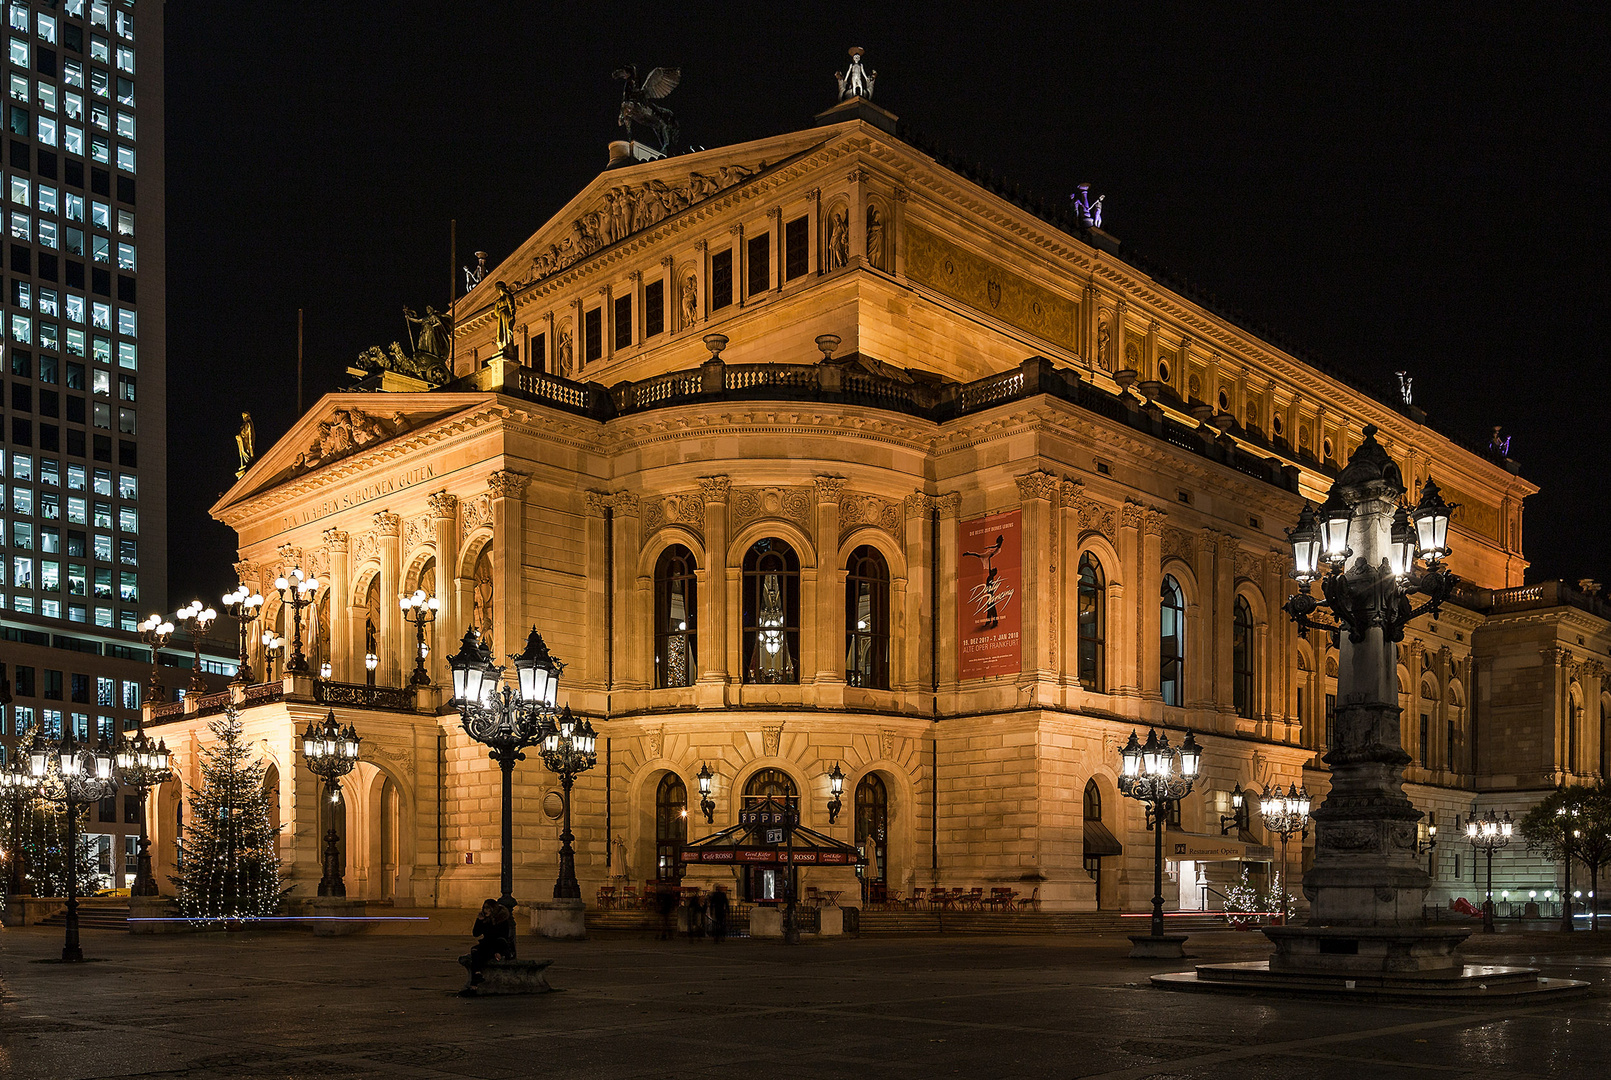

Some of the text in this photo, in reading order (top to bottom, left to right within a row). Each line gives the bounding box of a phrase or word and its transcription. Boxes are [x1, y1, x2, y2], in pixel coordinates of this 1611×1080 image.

[343, 478, 394, 507] SCHOENEN
[967, 576, 1008, 604] Dirty
[973, 586, 1015, 616] Dancing
[962, 639, 1019, 653] ALTE OPER FRANKFURT
[761, 815, 769, 823] P
[774, 815, 781, 823] P
